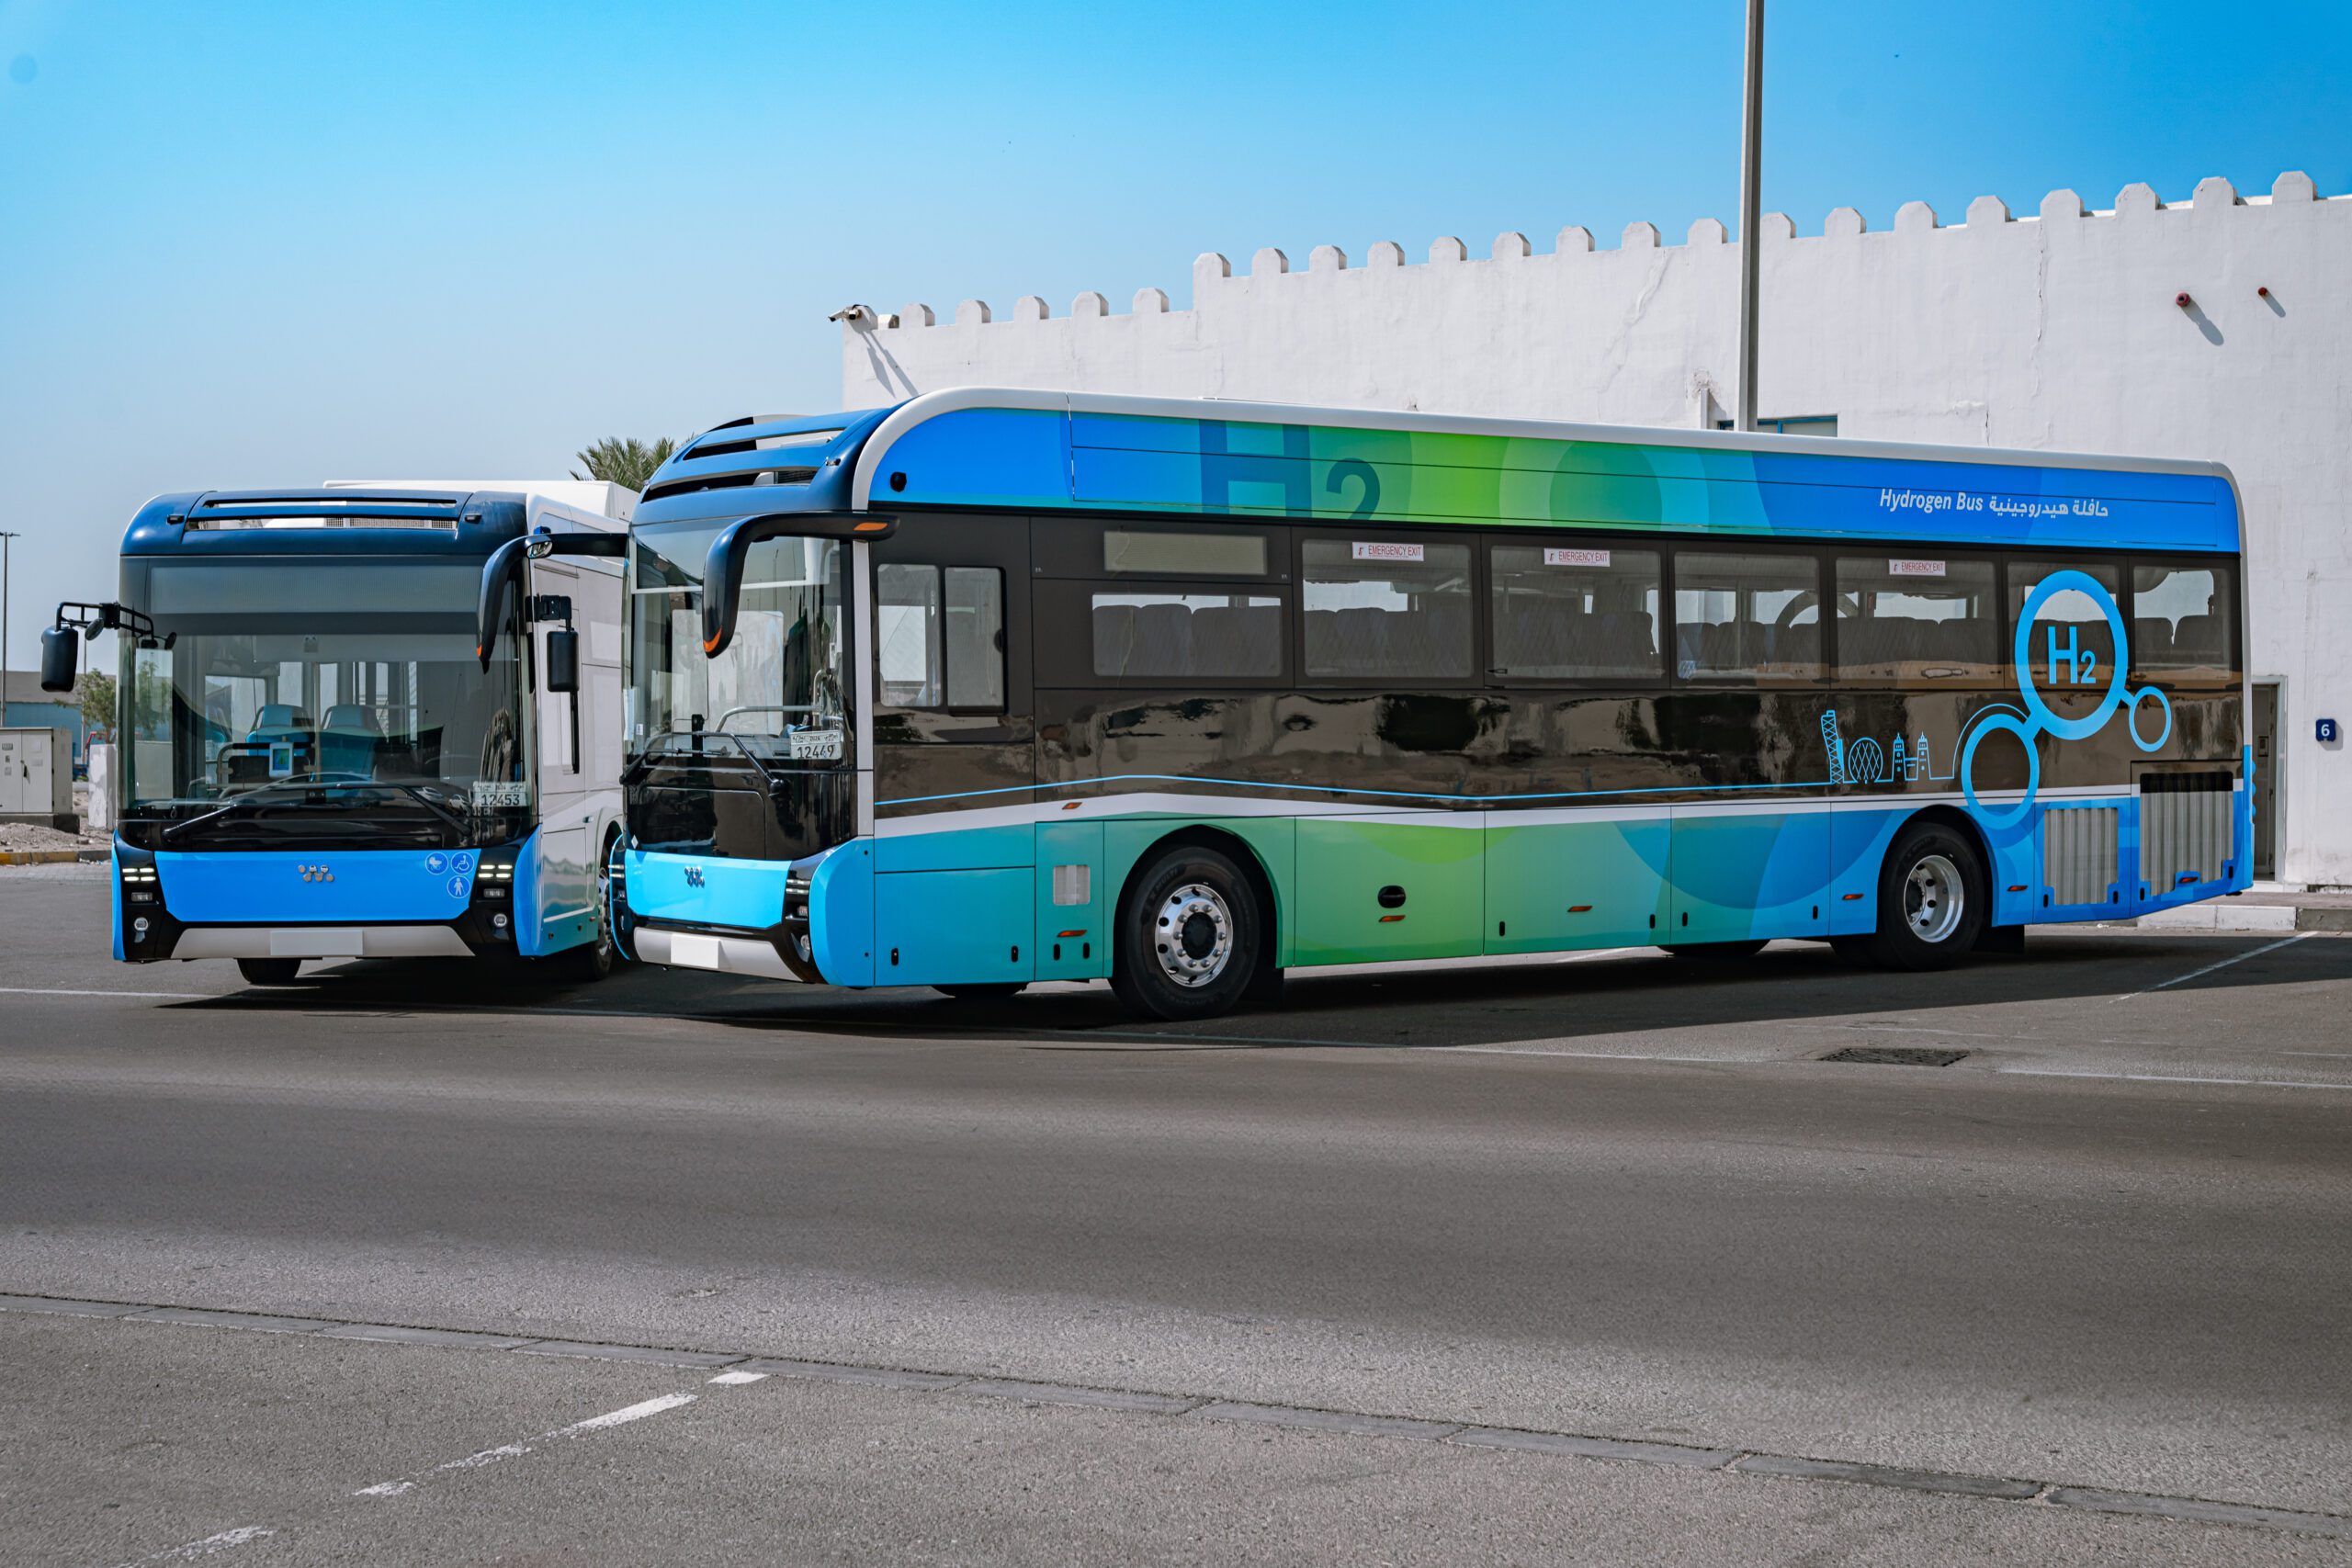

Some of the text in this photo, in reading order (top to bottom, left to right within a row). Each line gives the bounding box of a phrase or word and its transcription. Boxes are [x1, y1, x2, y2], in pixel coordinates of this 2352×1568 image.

[1880, 488, 1984, 513] Hydrogen Bus
[1989, 495, 2109, 518] حافلة هيدروجينية
[1368, 545, 1420, 557] EMERGENCY EXIT
[1558, 551, 1608, 562] EMERGENCY EXIT
[1901, 561, 1943, 571] EMERGENCY EXIT
[2047, 626, 2097, 684] H2
[2321, 723, 2331, 737] 6
[481, 794, 520, 807] 12453
